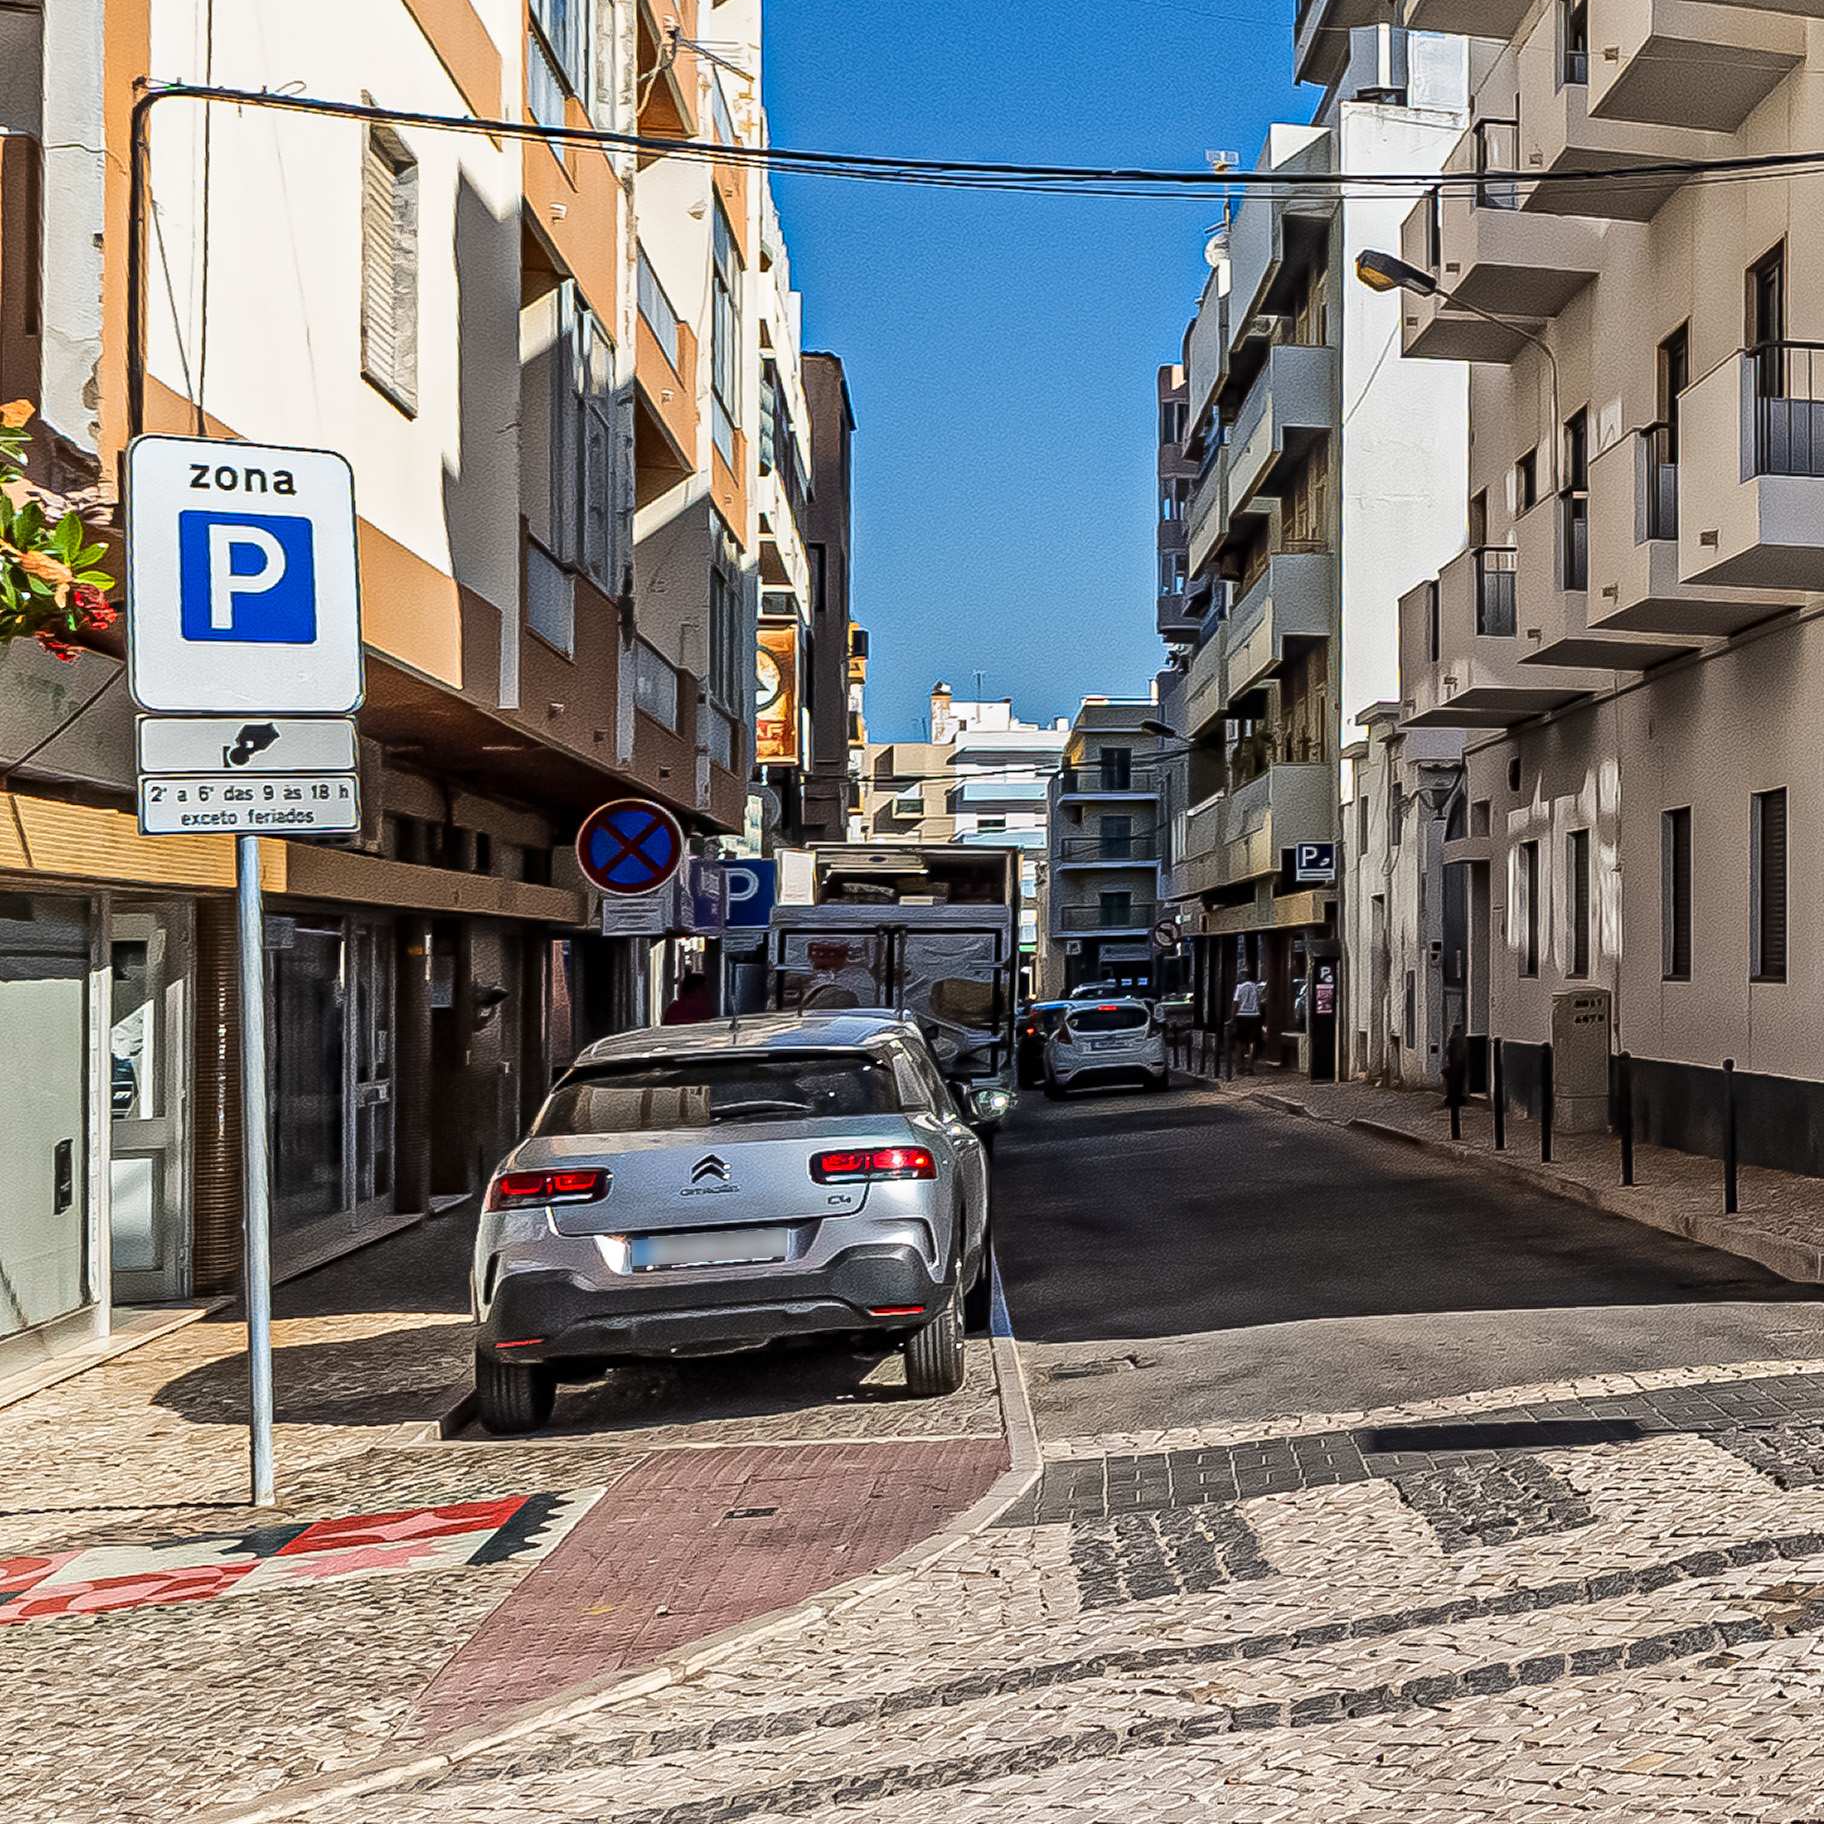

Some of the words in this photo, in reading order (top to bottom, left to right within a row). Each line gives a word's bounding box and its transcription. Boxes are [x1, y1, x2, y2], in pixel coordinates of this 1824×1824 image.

[189, 464, 297, 496] zona
[208, 523, 287, 630] P
[177, 789, 188, 802] a
[224, 785, 254, 801] das
[263, 785, 274, 801] 9
[311, 784, 330, 800] 18
[338, 784, 350, 799] h
[181, 810, 238, 826] exceto
[248, 808, 315, 825] feriados
[1301, 846, 1318, 867] P
[724, 866, 760, 921] P
[827, 1195, 851, 1205] C4
